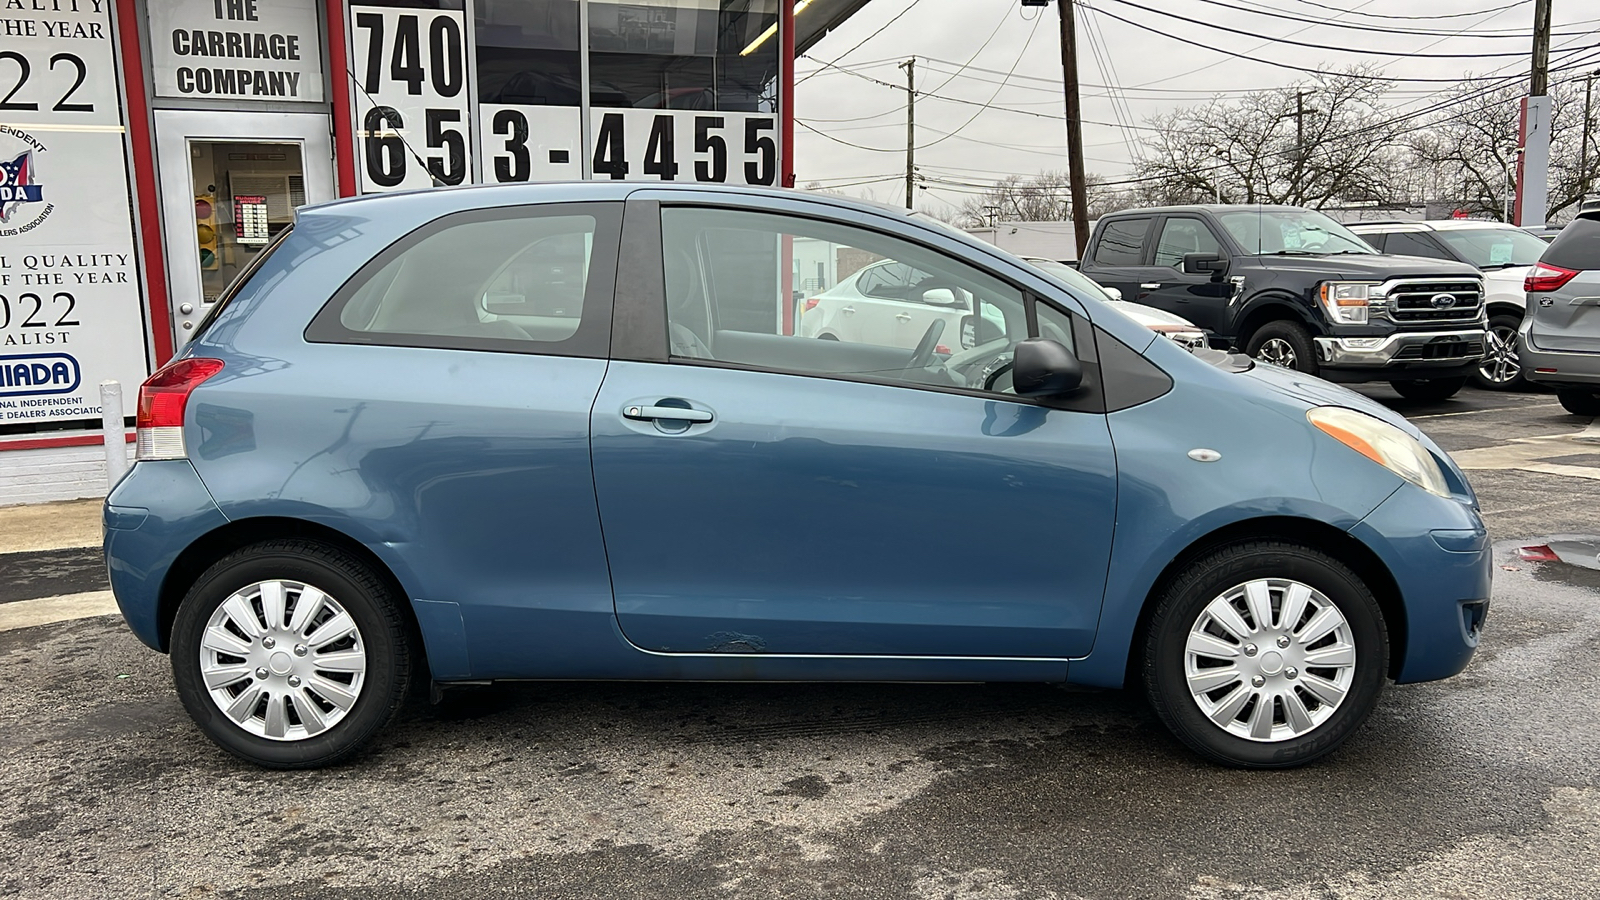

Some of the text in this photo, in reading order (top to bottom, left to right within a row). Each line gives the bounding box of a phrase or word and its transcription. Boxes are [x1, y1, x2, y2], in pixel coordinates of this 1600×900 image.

[213, 0, 259, 21] THE
[0, 19, 105, 39] HE YEAR
[172, 29, 300, 60] CARRIAGE
[356, 12, 464, 98] 740
[176, 66, 300, 97] COMPANY
[19, 203, 55, 234] ASSOCIATION
[23, 254, 128, 270] QUALITY
[21, 273, 64, 286] THE
[73, 272, 128, 284] YEAR
[4, 332, 70, 346] ALIST
[20, 397, 83, 408] INDEPENDENT
[7, 409, 47, 419] DEALERS
